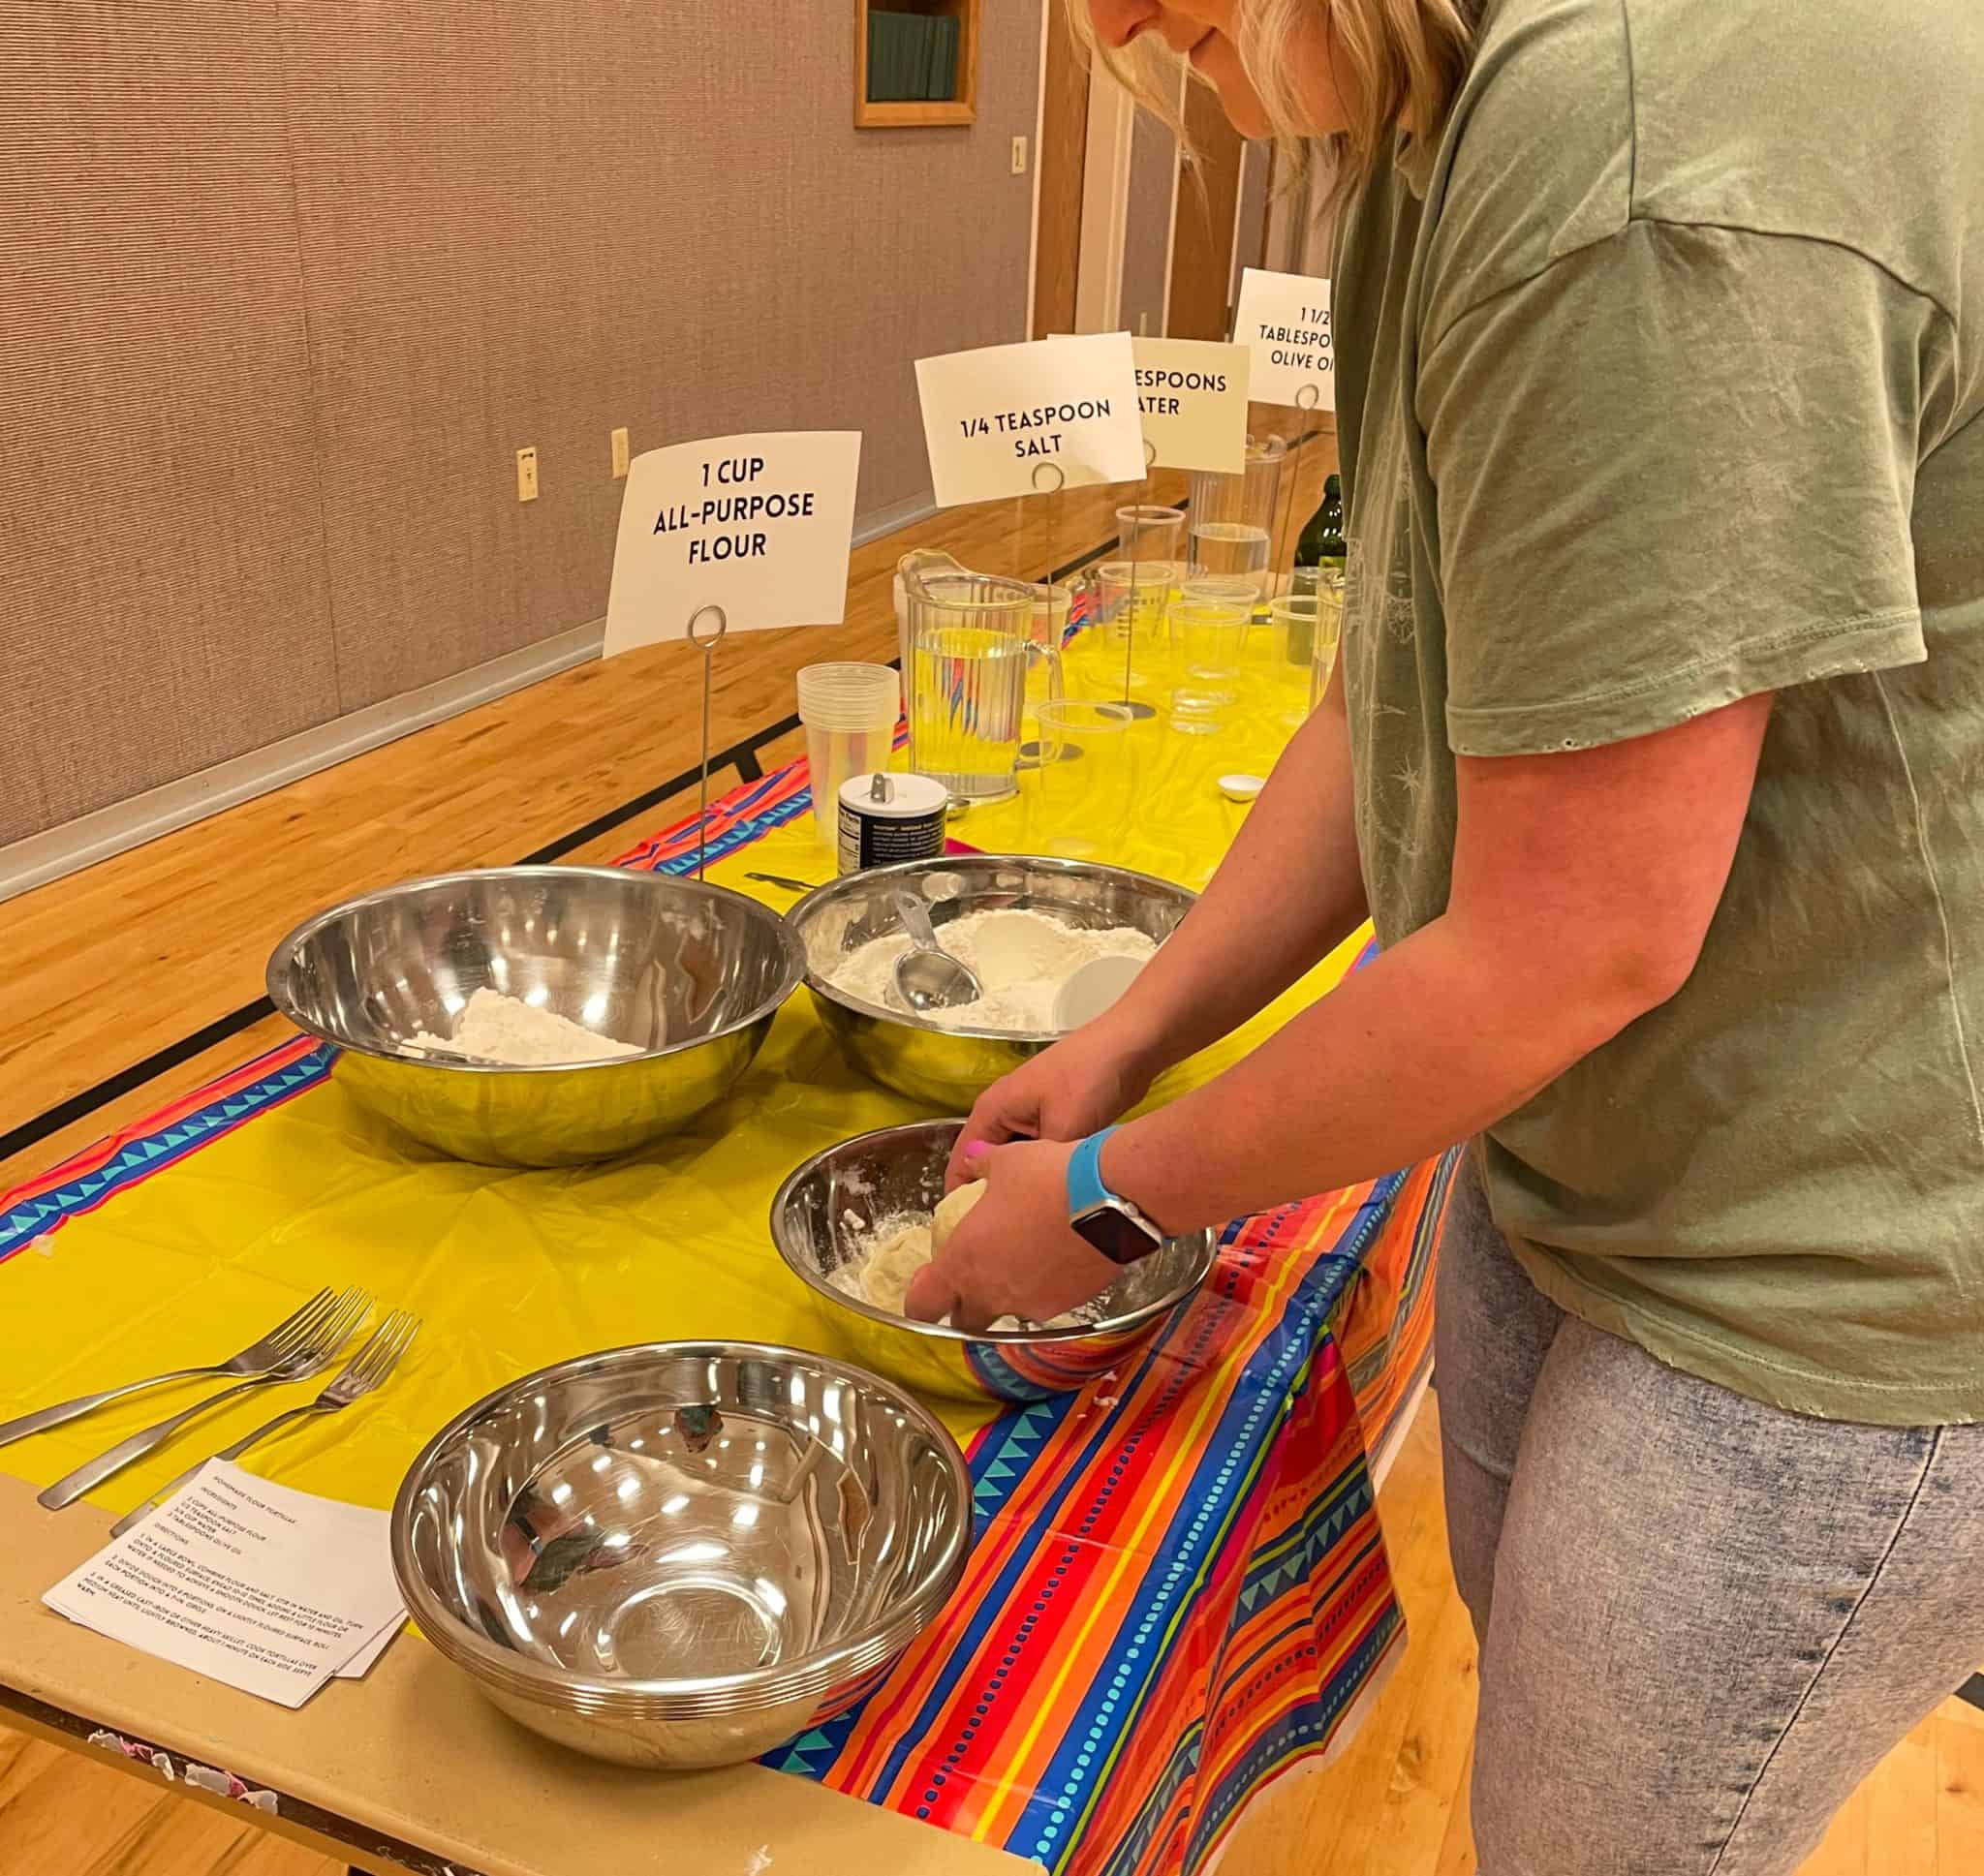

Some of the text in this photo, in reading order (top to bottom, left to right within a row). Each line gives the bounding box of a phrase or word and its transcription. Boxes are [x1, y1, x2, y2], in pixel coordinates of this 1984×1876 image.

[1300, 306, 1331, 325] 1 1/2
[1259, 324, 1333, 349] TABLESPO
[1271, 350, 1335, 371] OLIVE OI
[1134, 369, 1226, 392] ESPOONS
[1138, 396, 1180, 415] ATER
[960, 399, 1110, 438] 1/4 TEASPOON
[1014, 434, 1062, 458] SALT
[701, 458, 764, 488] 1 CUP
[653, 493, 815, 536] ALL-PURPOSE
[689, 533, 766, 564] FLOUR
